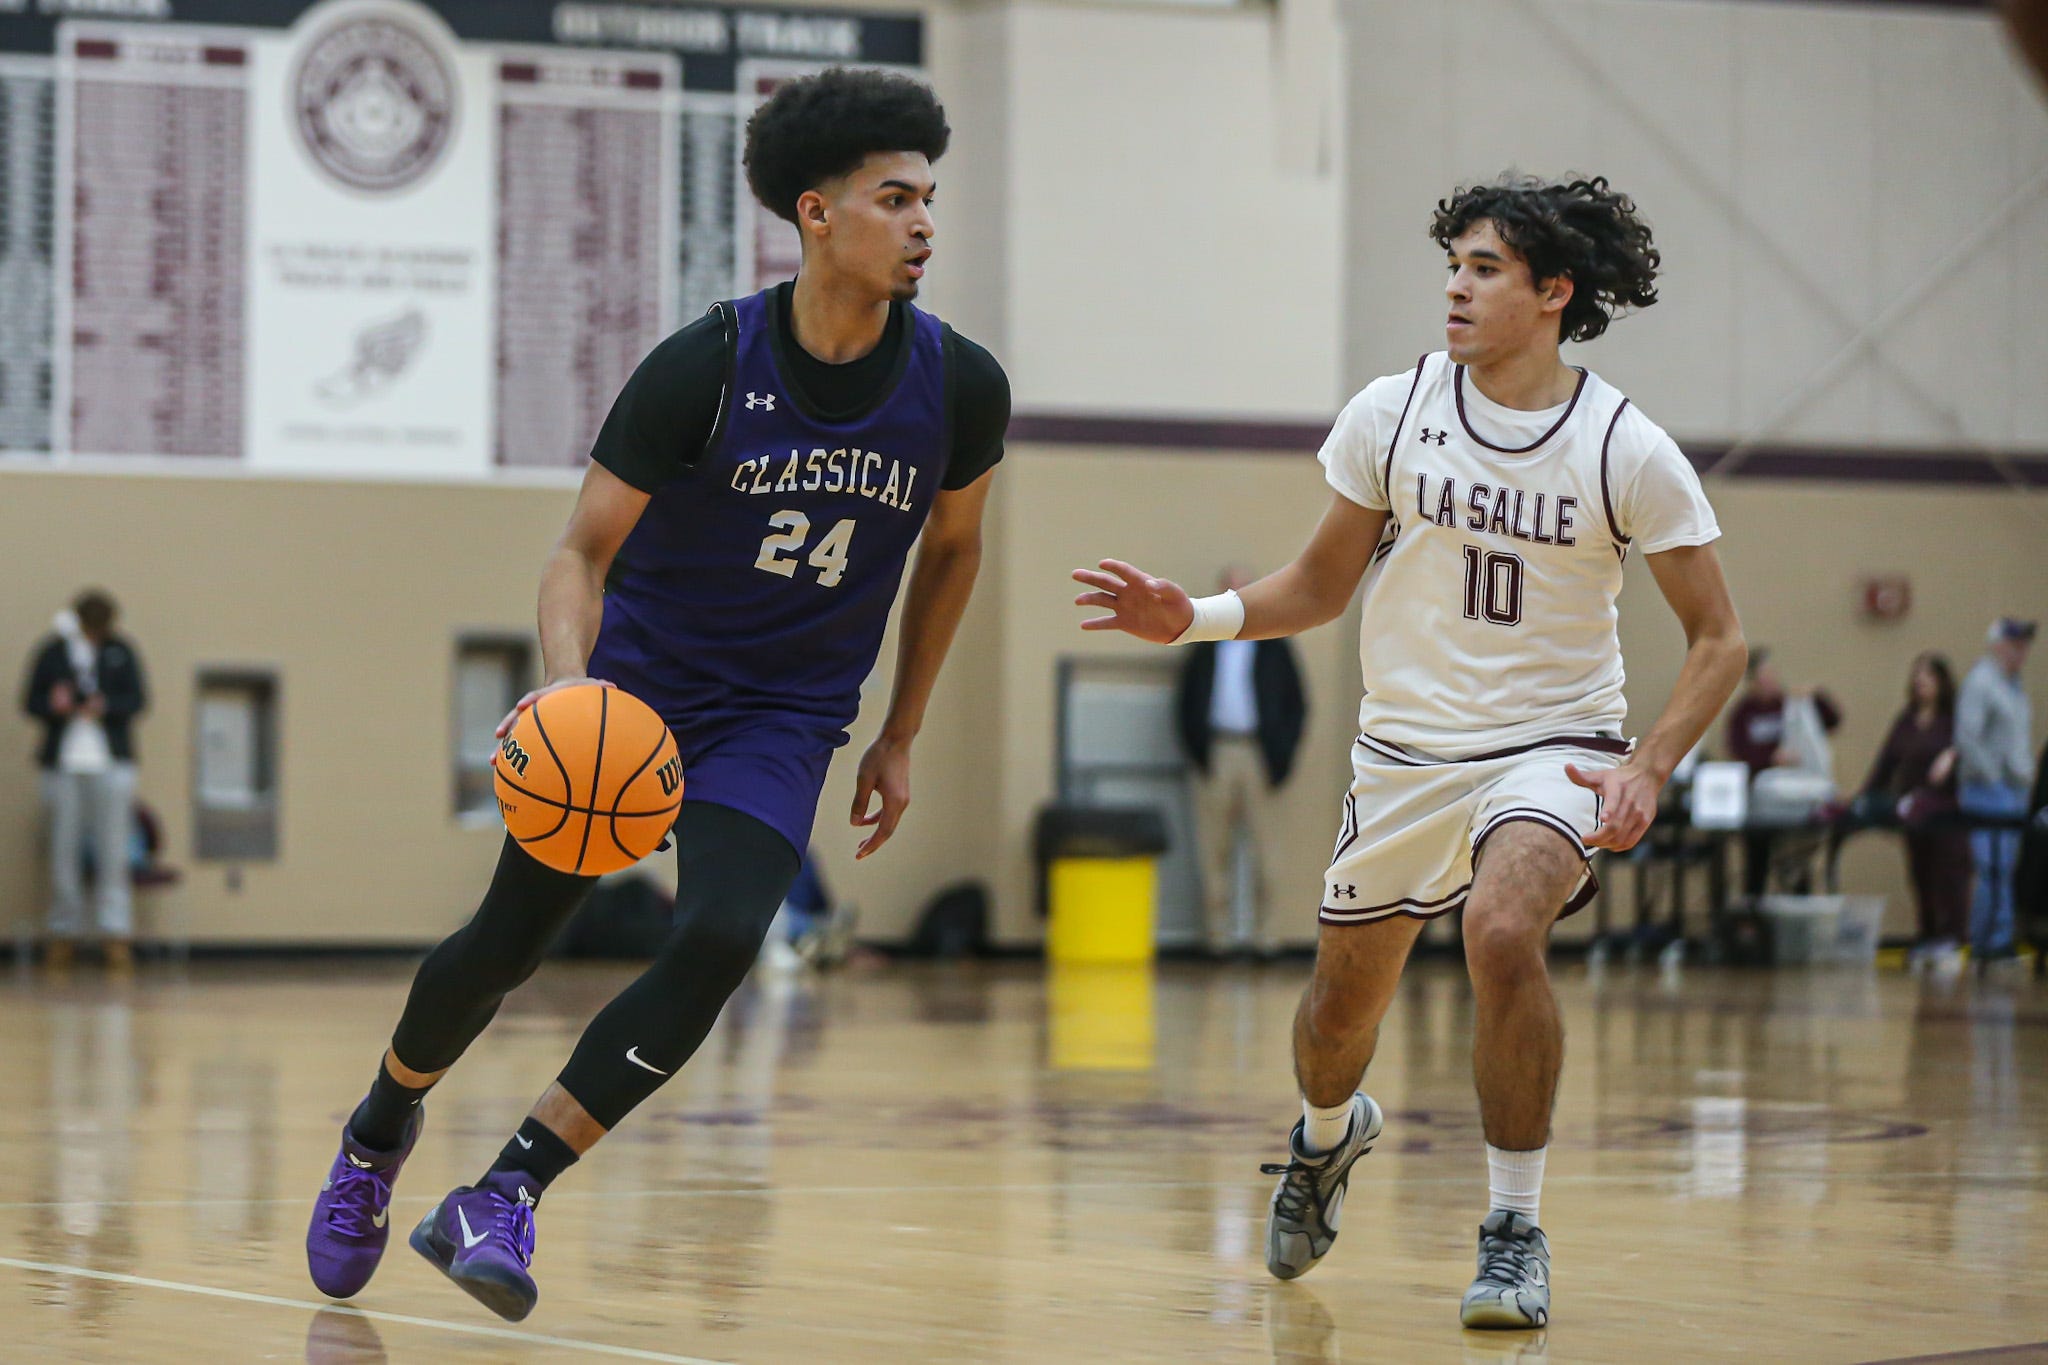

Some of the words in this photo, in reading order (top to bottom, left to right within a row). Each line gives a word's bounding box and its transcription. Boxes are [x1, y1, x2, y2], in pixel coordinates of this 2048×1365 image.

[730, 448, 917, 512] CLASSICAL
[1417, 472, 1456, 528] LA
[1466, 483, 1577, 546] SALLE
[753, 509, 857, 588] 24
[1463, 544, 1524, 627] 10
